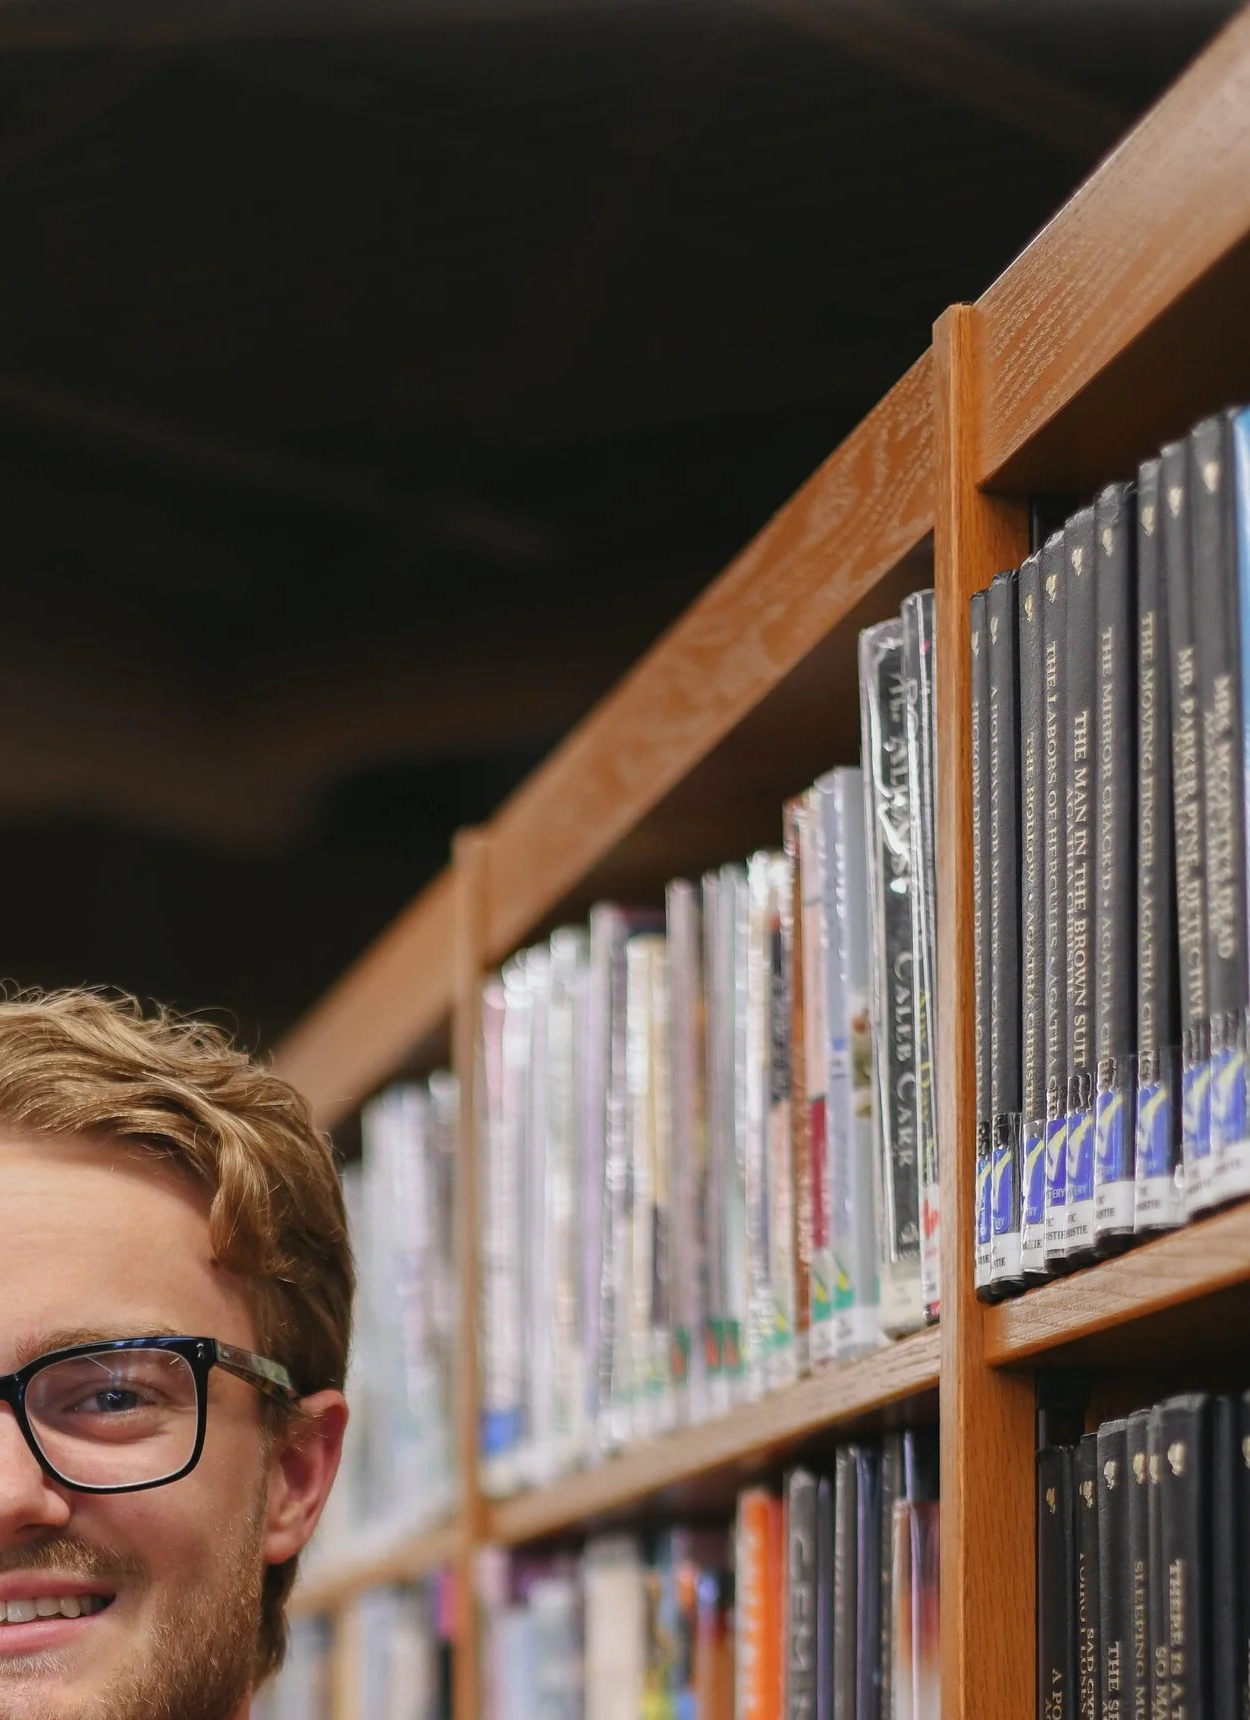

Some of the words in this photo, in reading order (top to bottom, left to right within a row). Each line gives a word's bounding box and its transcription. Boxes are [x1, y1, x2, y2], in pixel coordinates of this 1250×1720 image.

[1101, 627, 1114, 677] THE
[1141, 611, 1155, 661] THE
[1045, 640, 1058, 690] THE
[1046, 694, 1058, 784] LABORS
[1074, 710, 1089, 762] THE
[1101, 683, 1113, 781] MIRROR
[1047, 789, 1058, 821] OF
[1074, 766, 1088, 825] MAN
[1074, 829, 1087, 856] IN
[1074, 861, 1087, 913] THE
[1026, 911, 1036, 1005] AGATHA
[1074, 918, 1087, 1007] BROWN
[1100, 916, 1112, 1017] AGATHA
[1048, 973, 1059, 1069] AGATHA
[1073, 1013, 1087, 1069] SUIT
[1134, 1559, 1145, 1678] SLEEPING
[1052, 1668, 1063, 1685] A
[1086, 1628, 1095, 1673] SAD
[1107, 1640, 1120, 1692] THE
